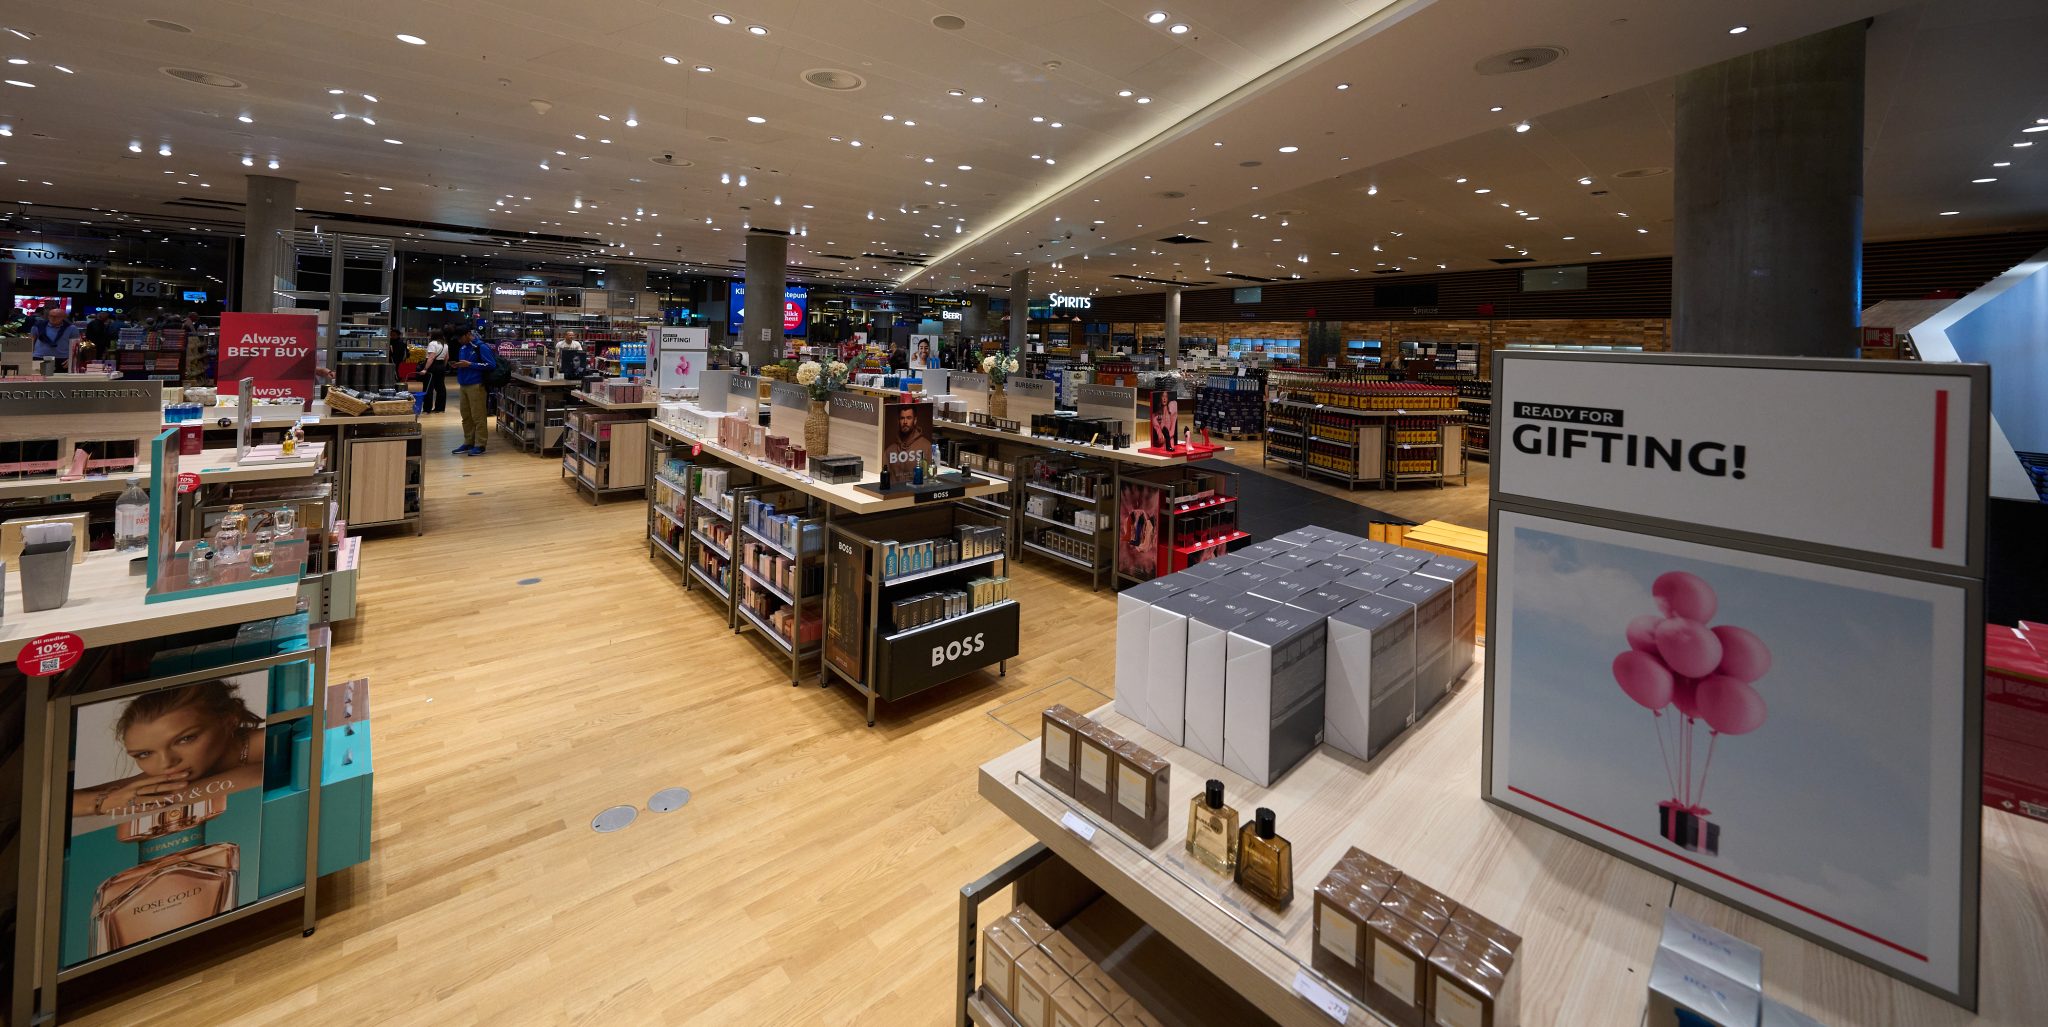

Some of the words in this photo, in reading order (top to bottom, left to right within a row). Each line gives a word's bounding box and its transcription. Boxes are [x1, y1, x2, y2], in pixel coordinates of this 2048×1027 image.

[62, 278, 84, 289] 27
[136, 282, 156, 293] 26
[433, 279, 484, 294] SWEETS
[495, 287, 525, 296] SWEETS
[1049, 293, 1091, 308] SPIRITS
[241, 333, 297, 346] Always
[228, 347, 271, 357] BEST
[275, 347, 309, 357] BUY
[732, 378, 751, 390] CLEAN
[1015, 381, 1044, 390] BURBERRY
[72, 389, 152, 398] HERRERA
[253, 386, 292, 397] lways
[1521, 405, 1575, 421] READY
[1580, 410, 1614, 424] FOR
[890, 450, 923, 464] BOSS
[1512, 423, 1747, 480] GIFTING!
[933, 491, 949, 499] BOSS
[838, 541, 853, 555] BOSS
[36, 641, 68, 655] 10%
[931, 632, 985, 667] BOSS
[106, 791, 187, 820] TIFFANY
[189, 787, 202, 799] &
[133, 899, 164, 915] ROSE
[167, 887, 202, 904] GOLD
